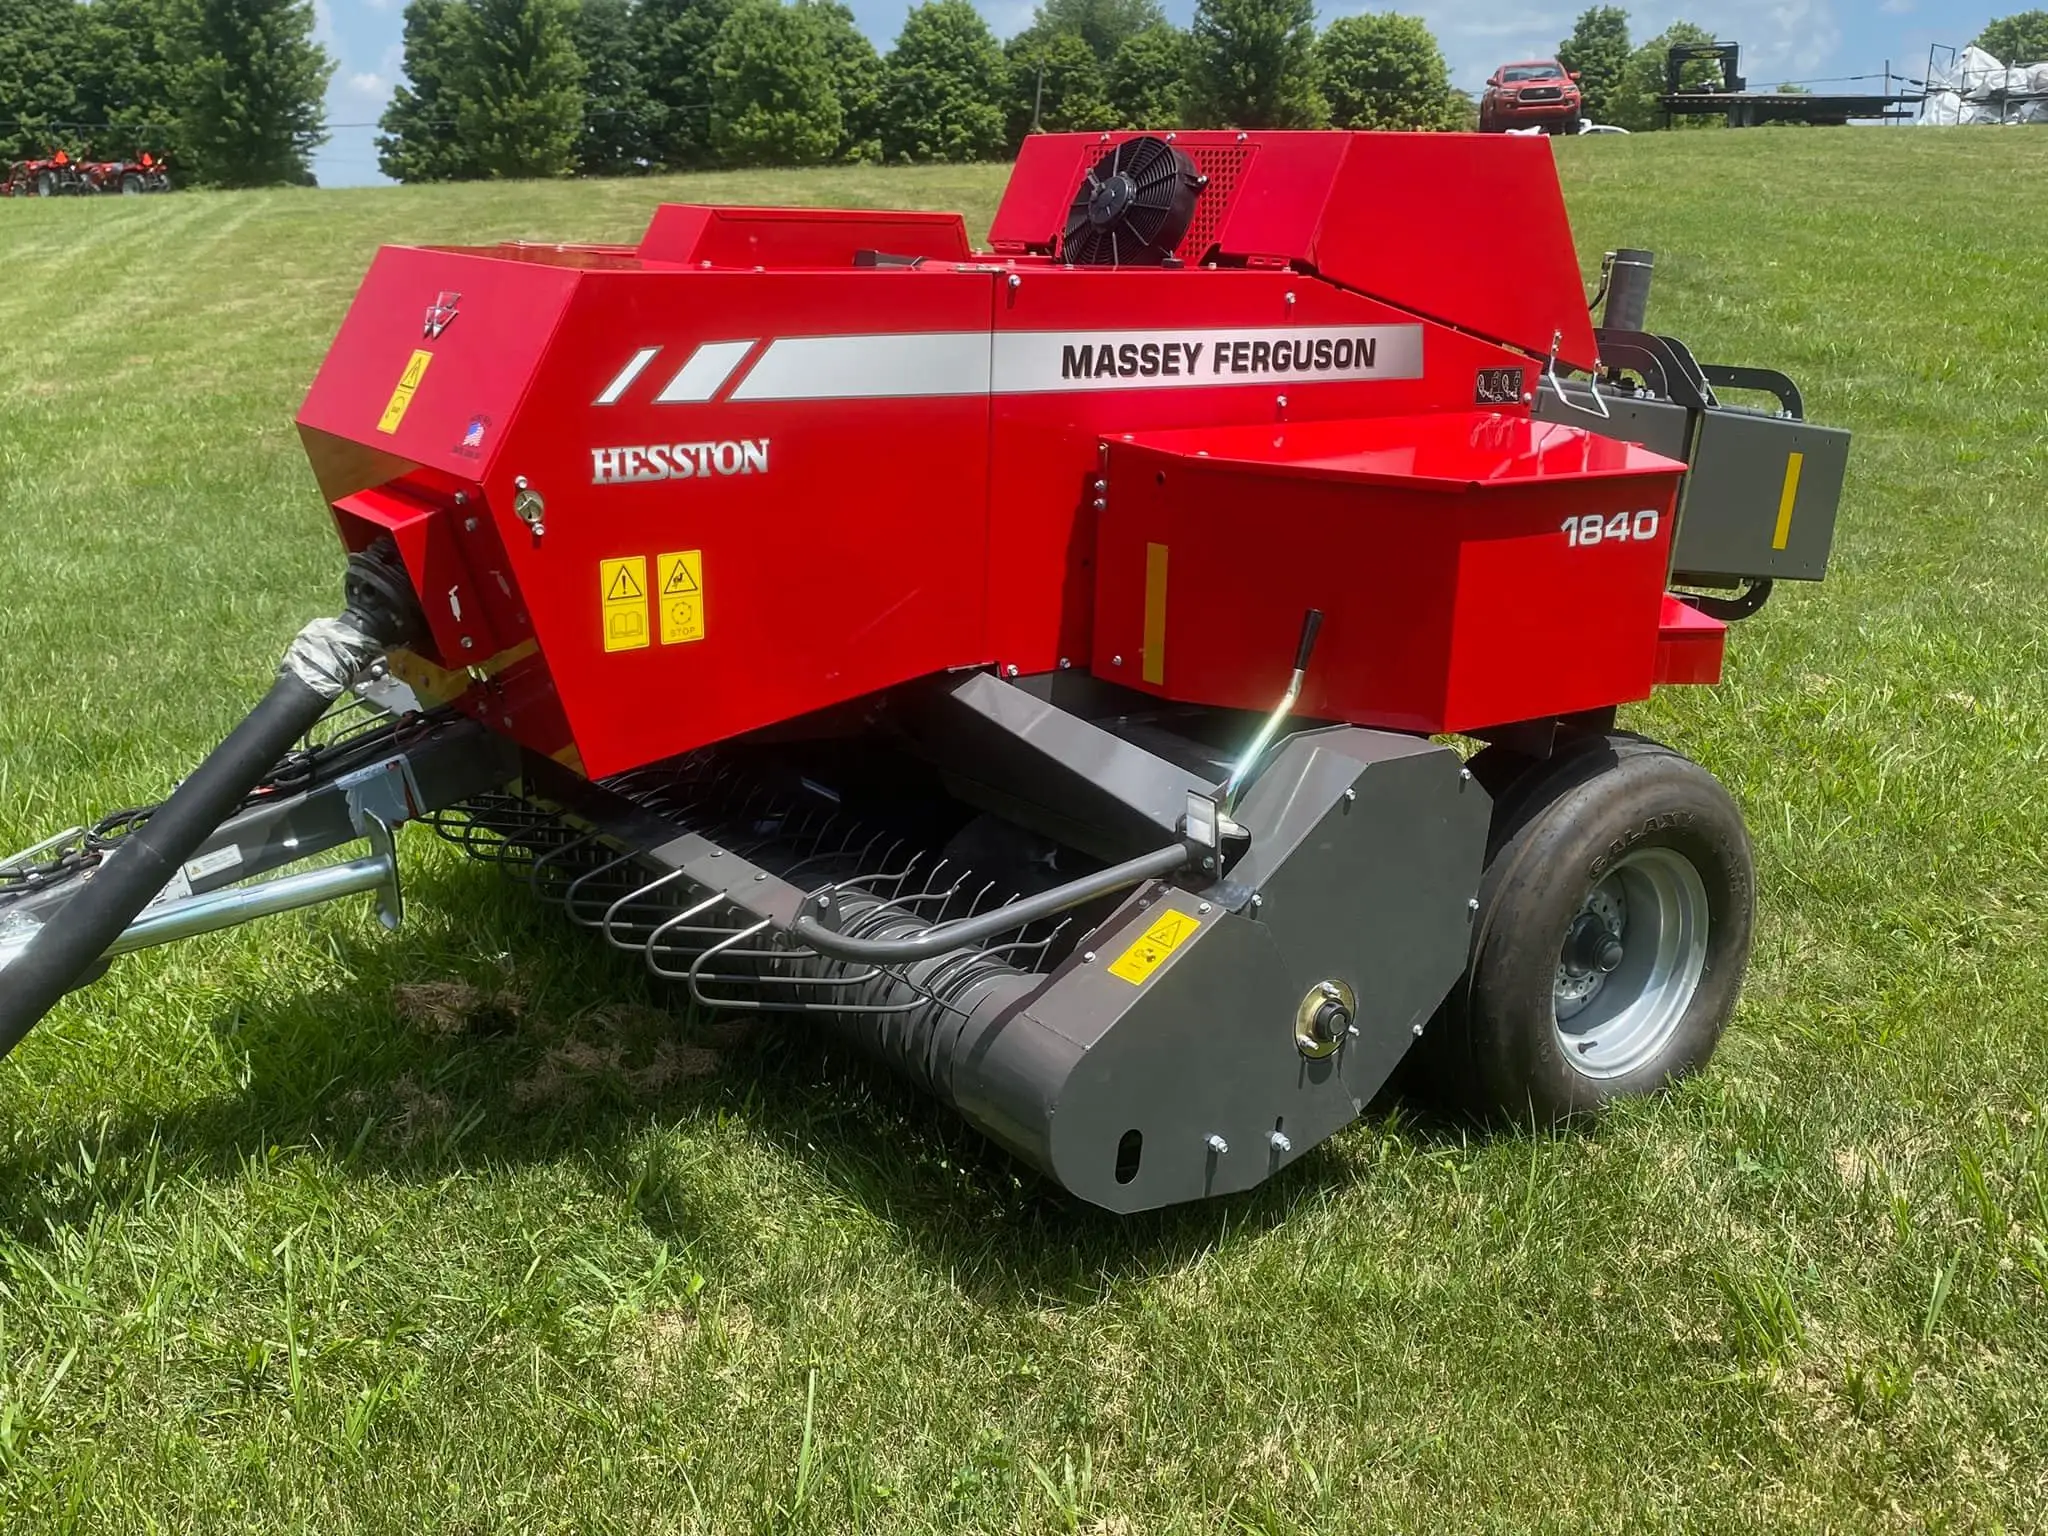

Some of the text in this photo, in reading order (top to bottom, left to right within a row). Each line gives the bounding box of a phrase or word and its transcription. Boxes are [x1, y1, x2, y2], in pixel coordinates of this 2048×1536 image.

[1061, 337, 1376, 379] MASSEY FERGUSON
[592, 438, 770, 484] HESSTON
[1561, 510, 1659, 547] 1840
[670, 626, 696, 637] STOP
[1590, 809, 1697, 879] GALAXY
